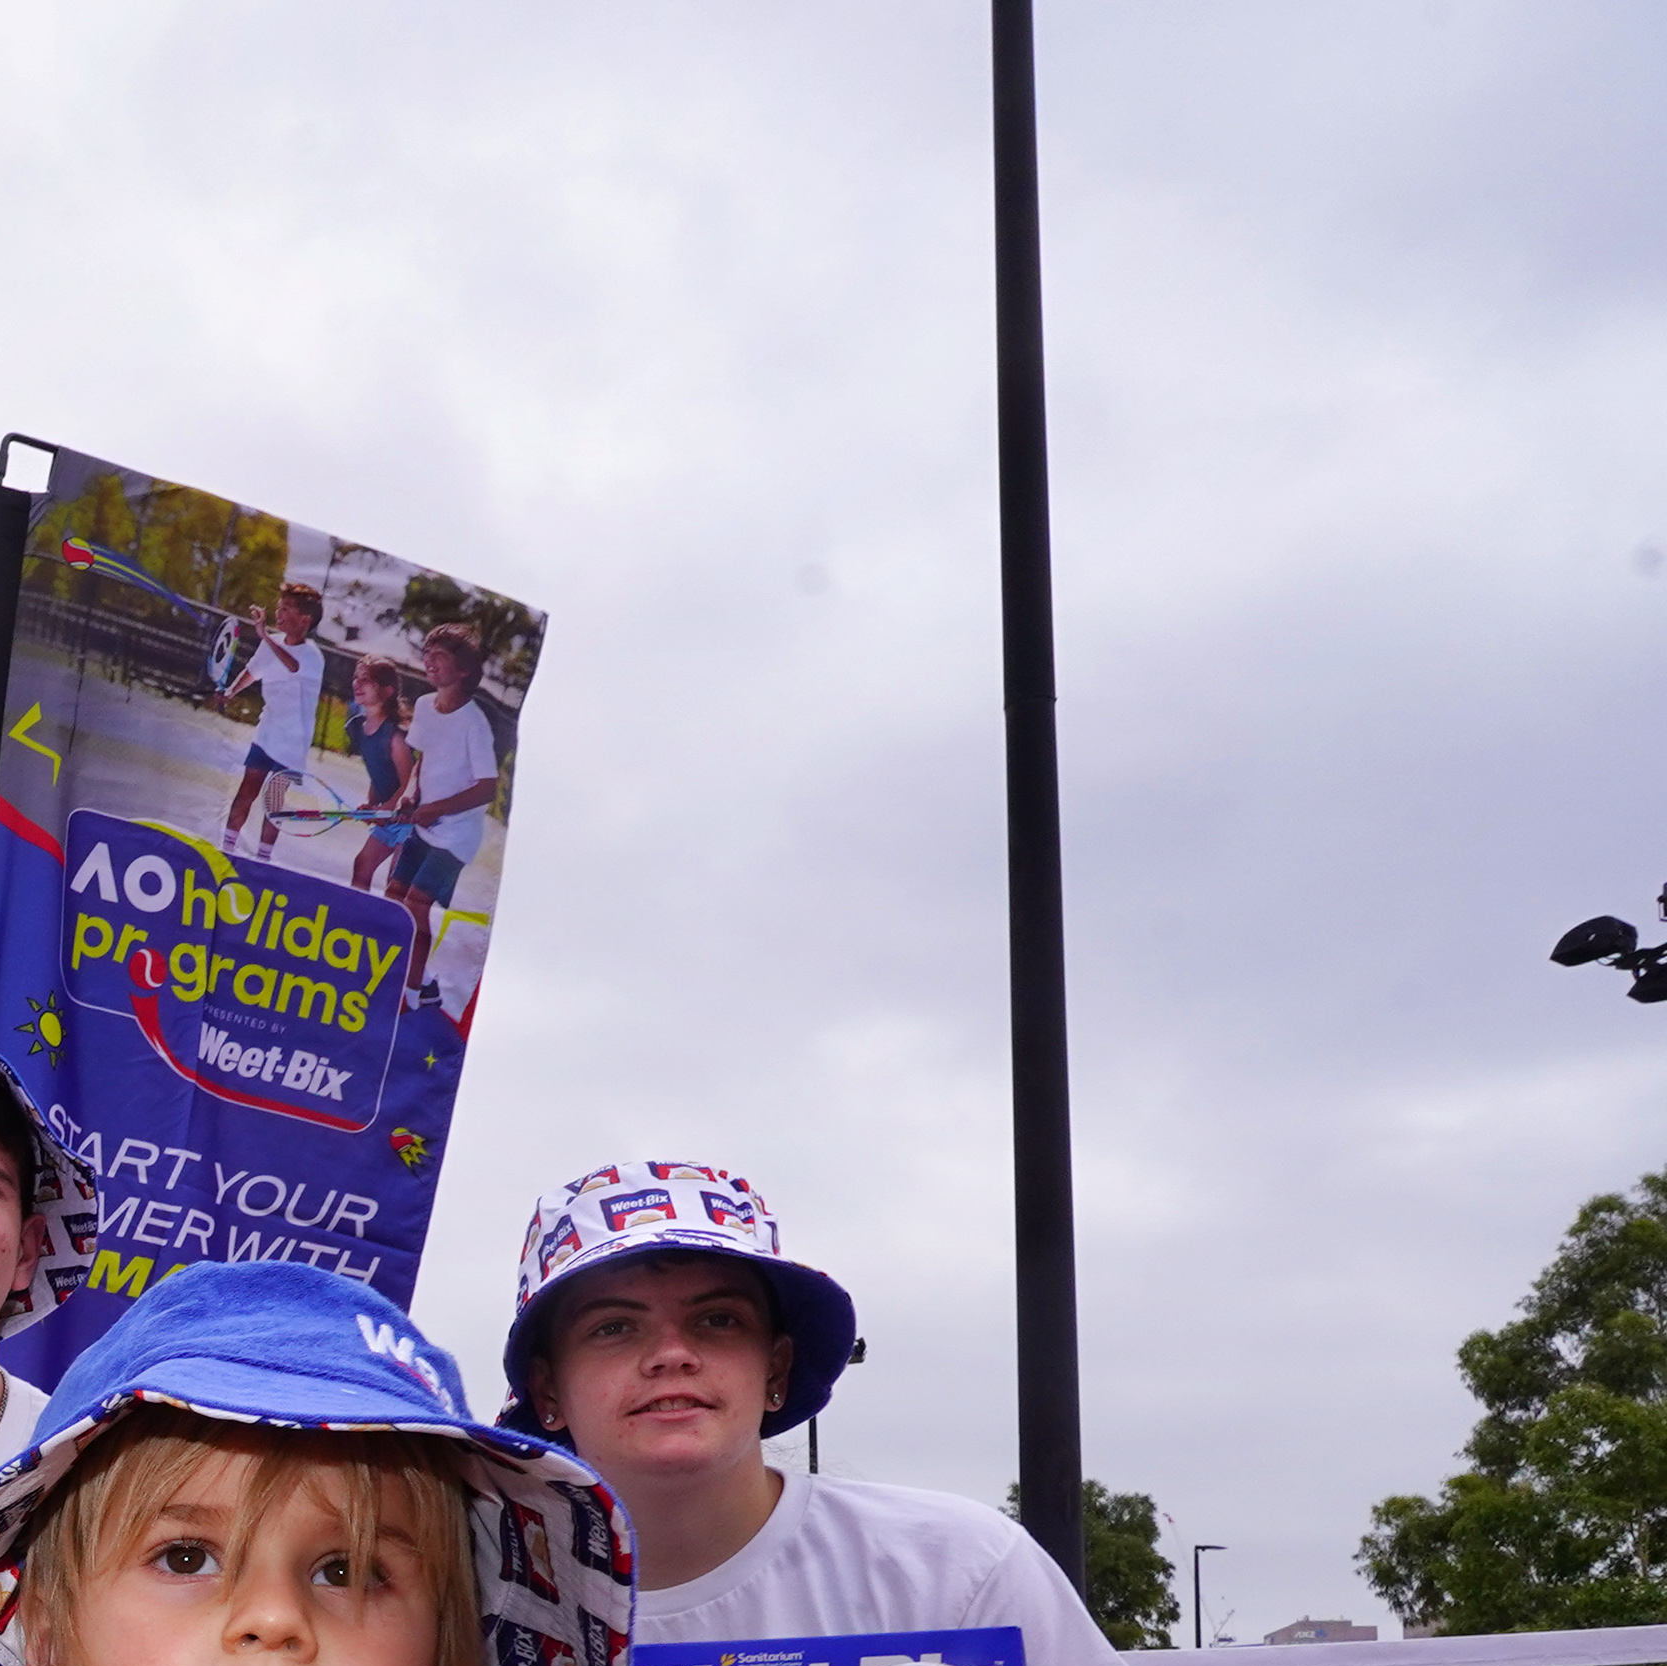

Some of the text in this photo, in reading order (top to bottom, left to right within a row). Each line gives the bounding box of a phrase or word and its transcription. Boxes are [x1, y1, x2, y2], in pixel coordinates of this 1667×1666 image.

[203, 1002, 287, 1035] PRESENTED BY
[197, 1021, 353, 1102] Weet-Bix
[48, 1103, 380, 1239] START YOUR
[610, 1193, 669, 1214] Weet-Bix
